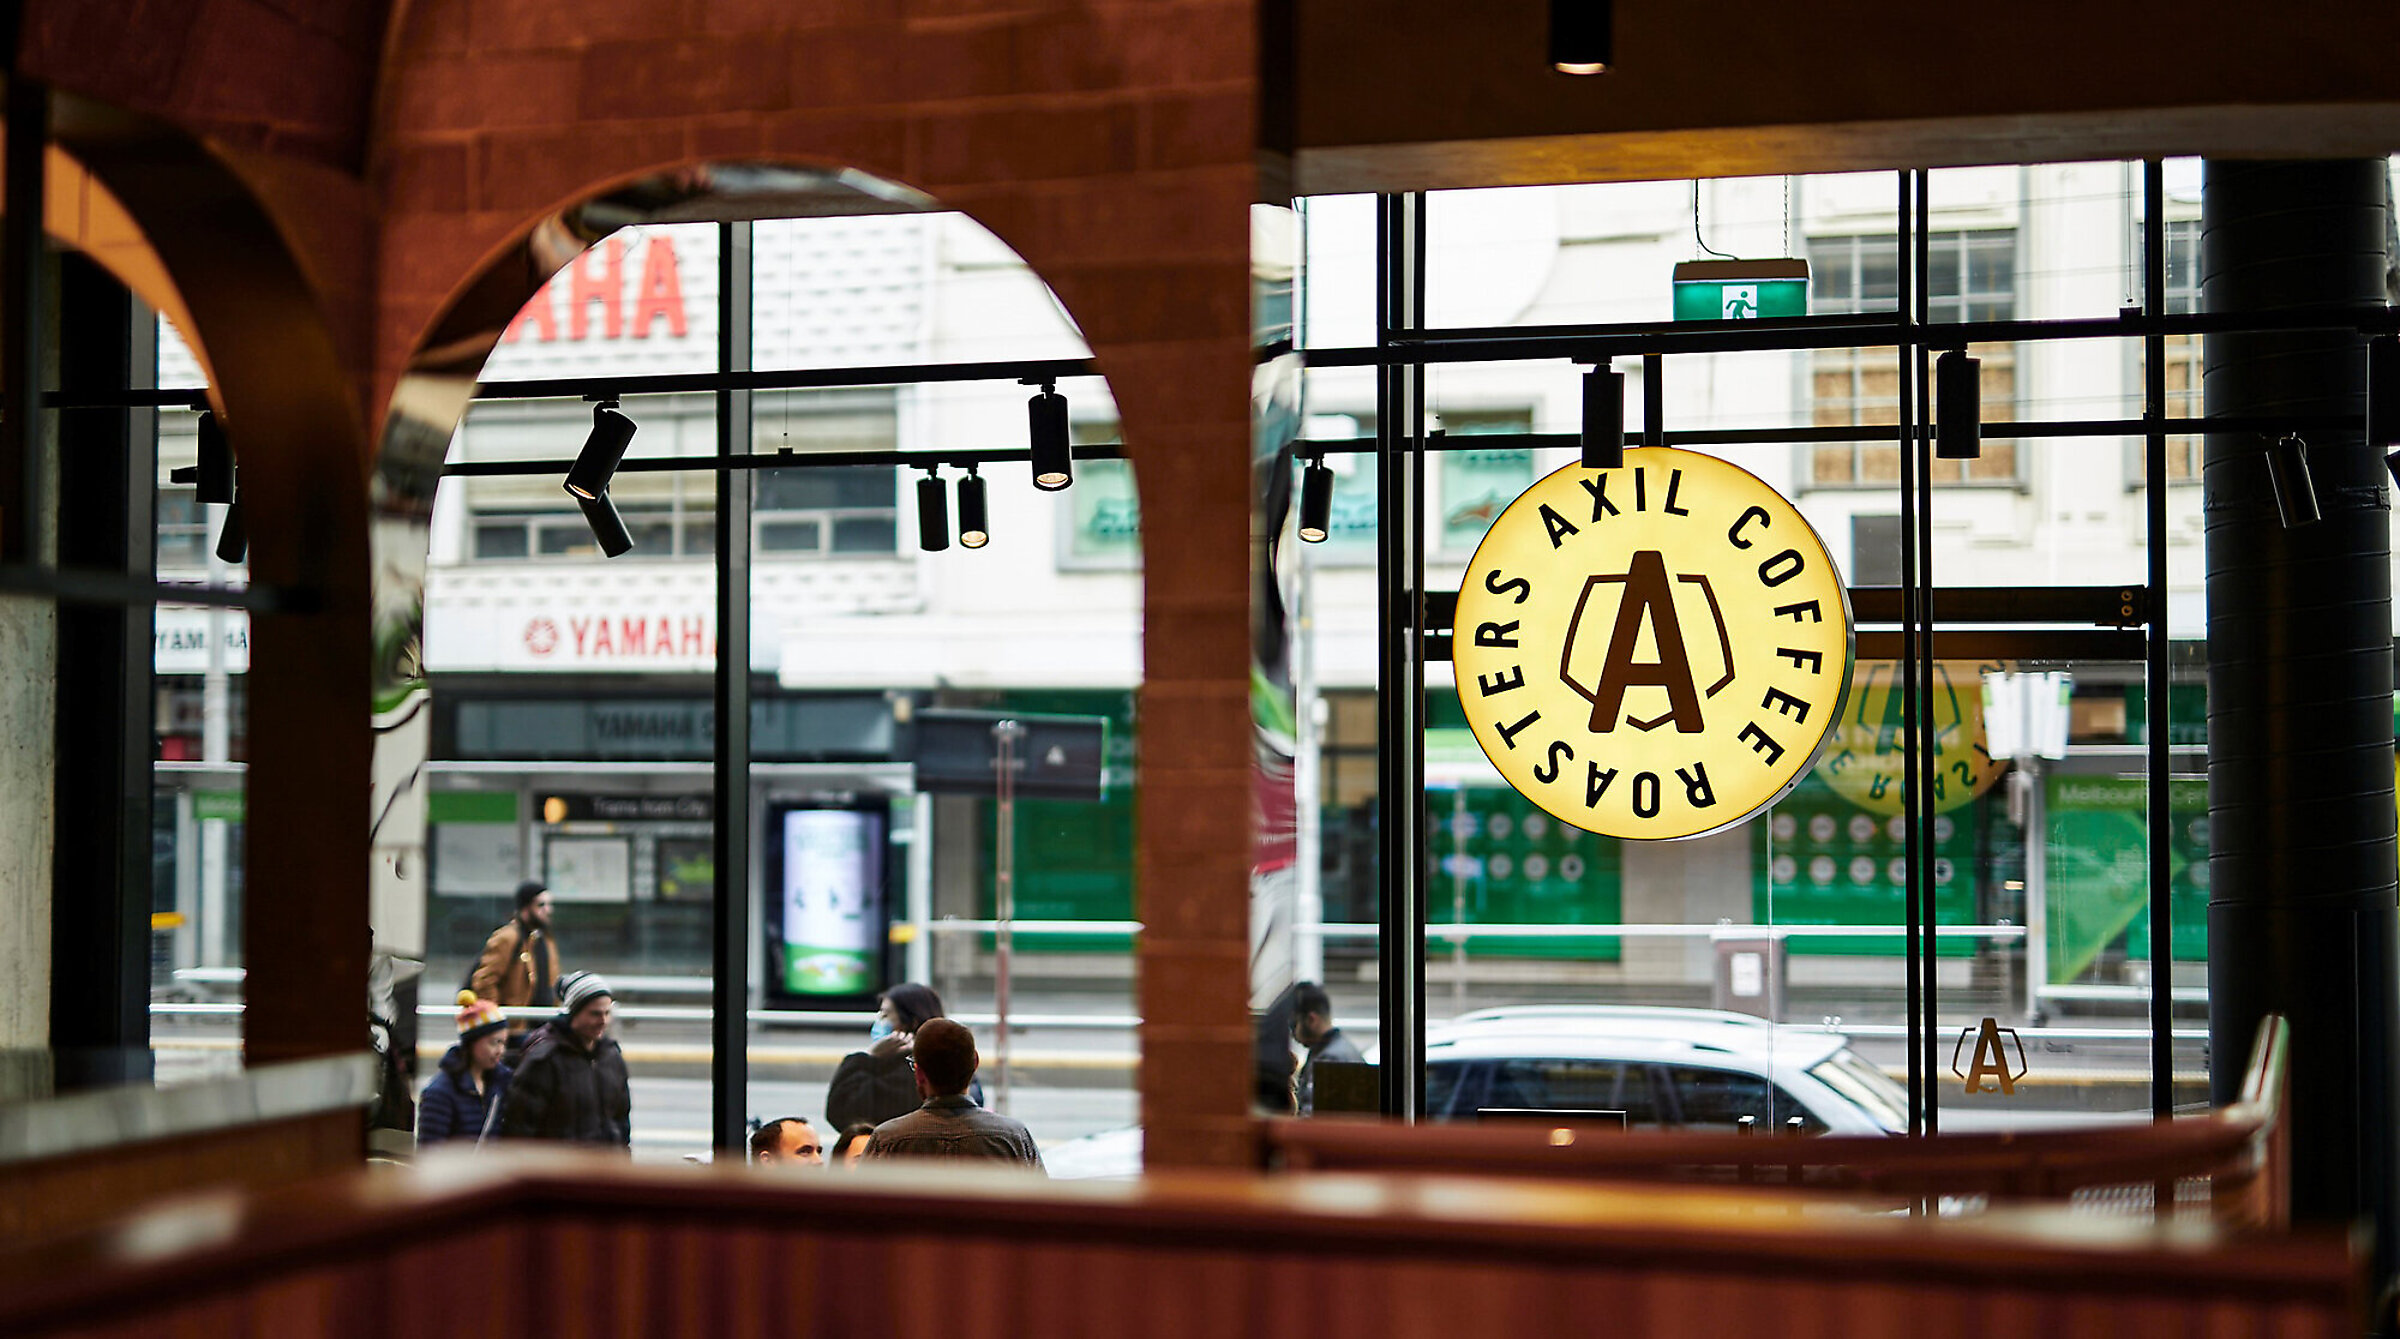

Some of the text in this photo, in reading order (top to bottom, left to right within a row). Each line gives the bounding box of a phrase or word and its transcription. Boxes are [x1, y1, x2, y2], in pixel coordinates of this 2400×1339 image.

[1538, 467, 1689, 549] AXIL
[570, 615, 716, 656] YAMAH
[1475, 569, 1716, 818] ROASTERS
[1588, 550, 1705, 733] A
[1728, 506, 1823, 768] COFFEE
[595, 709, 693, 738] YAMAHA
